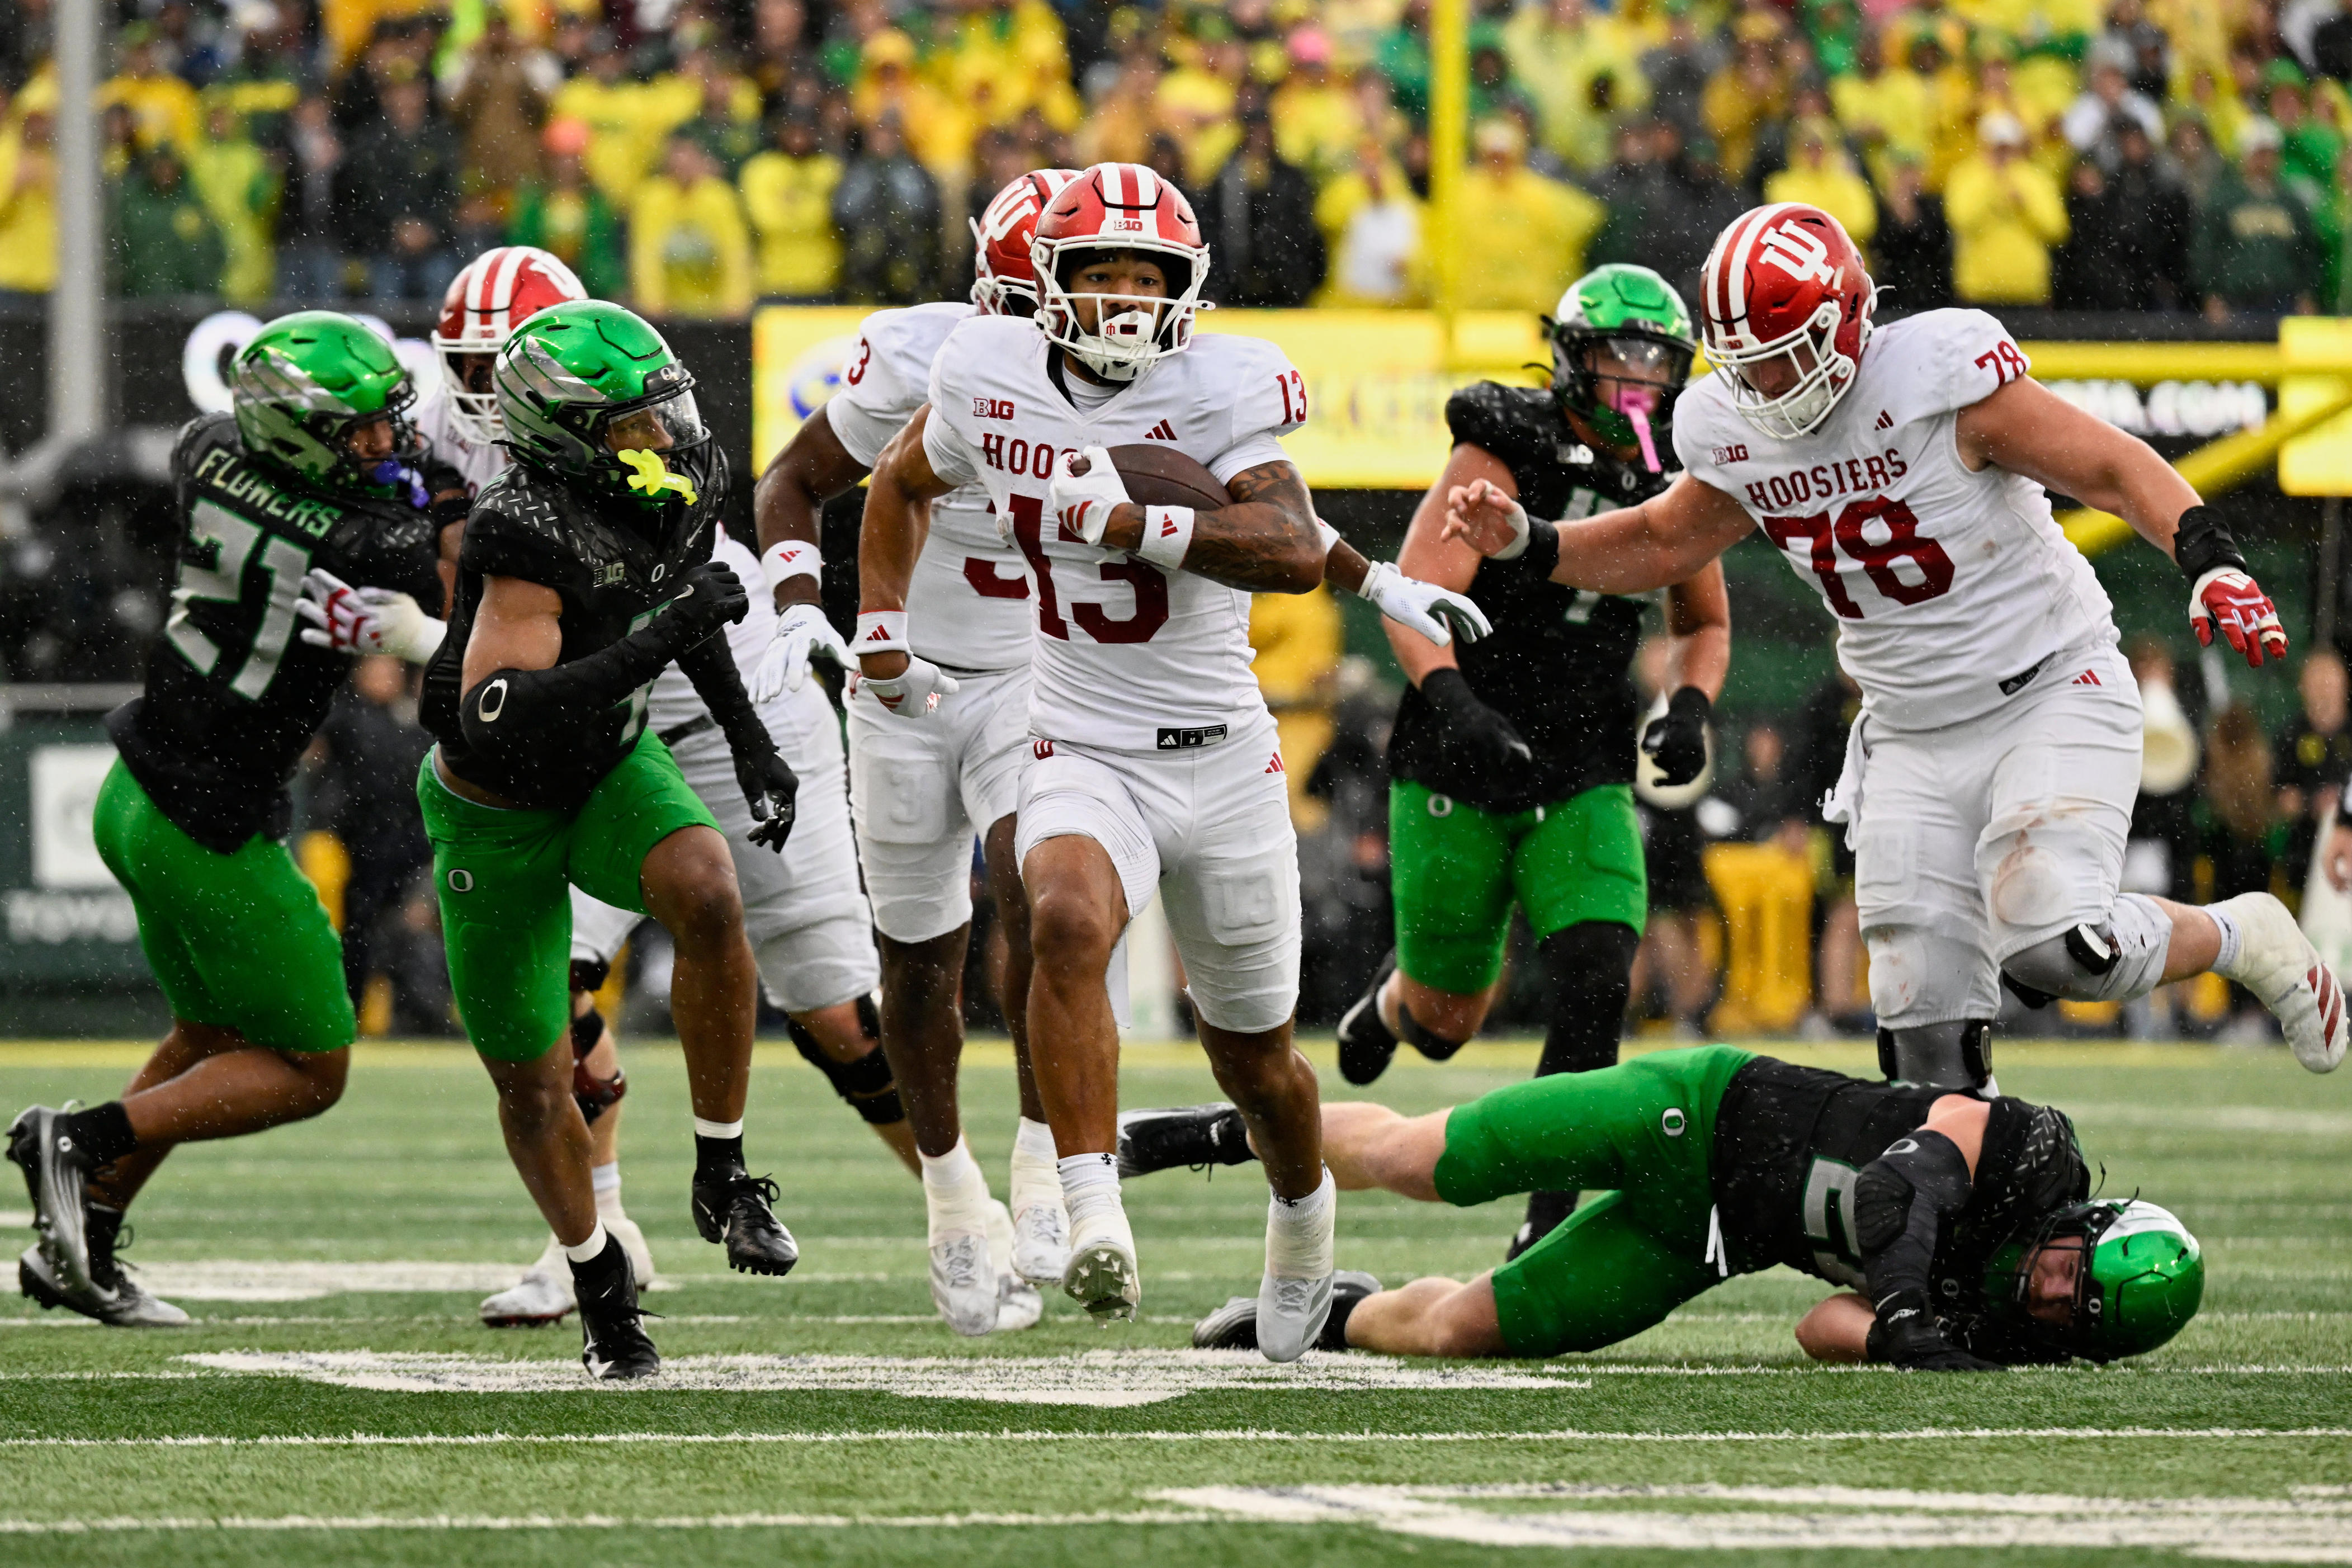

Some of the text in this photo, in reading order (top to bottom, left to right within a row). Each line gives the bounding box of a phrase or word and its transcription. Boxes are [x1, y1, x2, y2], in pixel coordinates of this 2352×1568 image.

[1276, 370, 1307, 425] 13
[1974, 341, 2026, 386] 78
[194, 447, 343, 539] FLOWERS
[1745, 448, 1908, 511] HOOSIERS
[166, 496, 313, 702] 21
[1008, 490, 1170, 644] 13
[1762, 494, 1956, 619] 78
